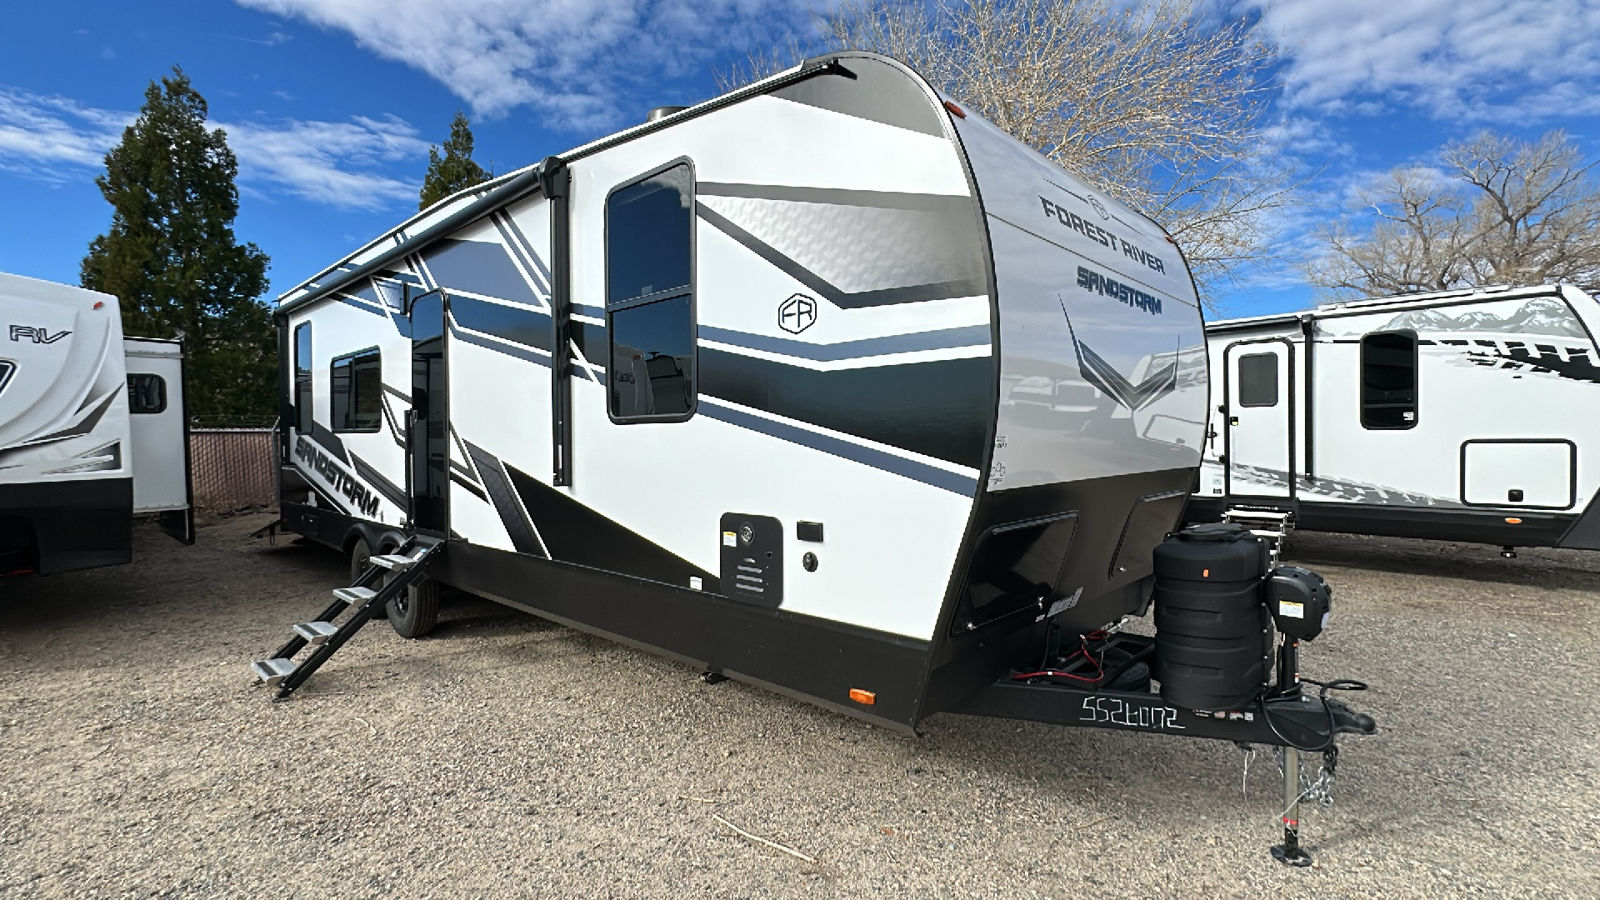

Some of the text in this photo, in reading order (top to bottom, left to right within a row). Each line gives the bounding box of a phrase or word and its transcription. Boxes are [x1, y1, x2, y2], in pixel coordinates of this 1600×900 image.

[1038, 195, 1117, 251] FOREST
[1120, 238, 1166, 275] RIVER
[781, 298, 813, 329] FR
[1076, 265, 1163, 315] SANDSTORM
[9, 324, 73, 344] RV
[295, 436, 381, 519] SANDSTORM
